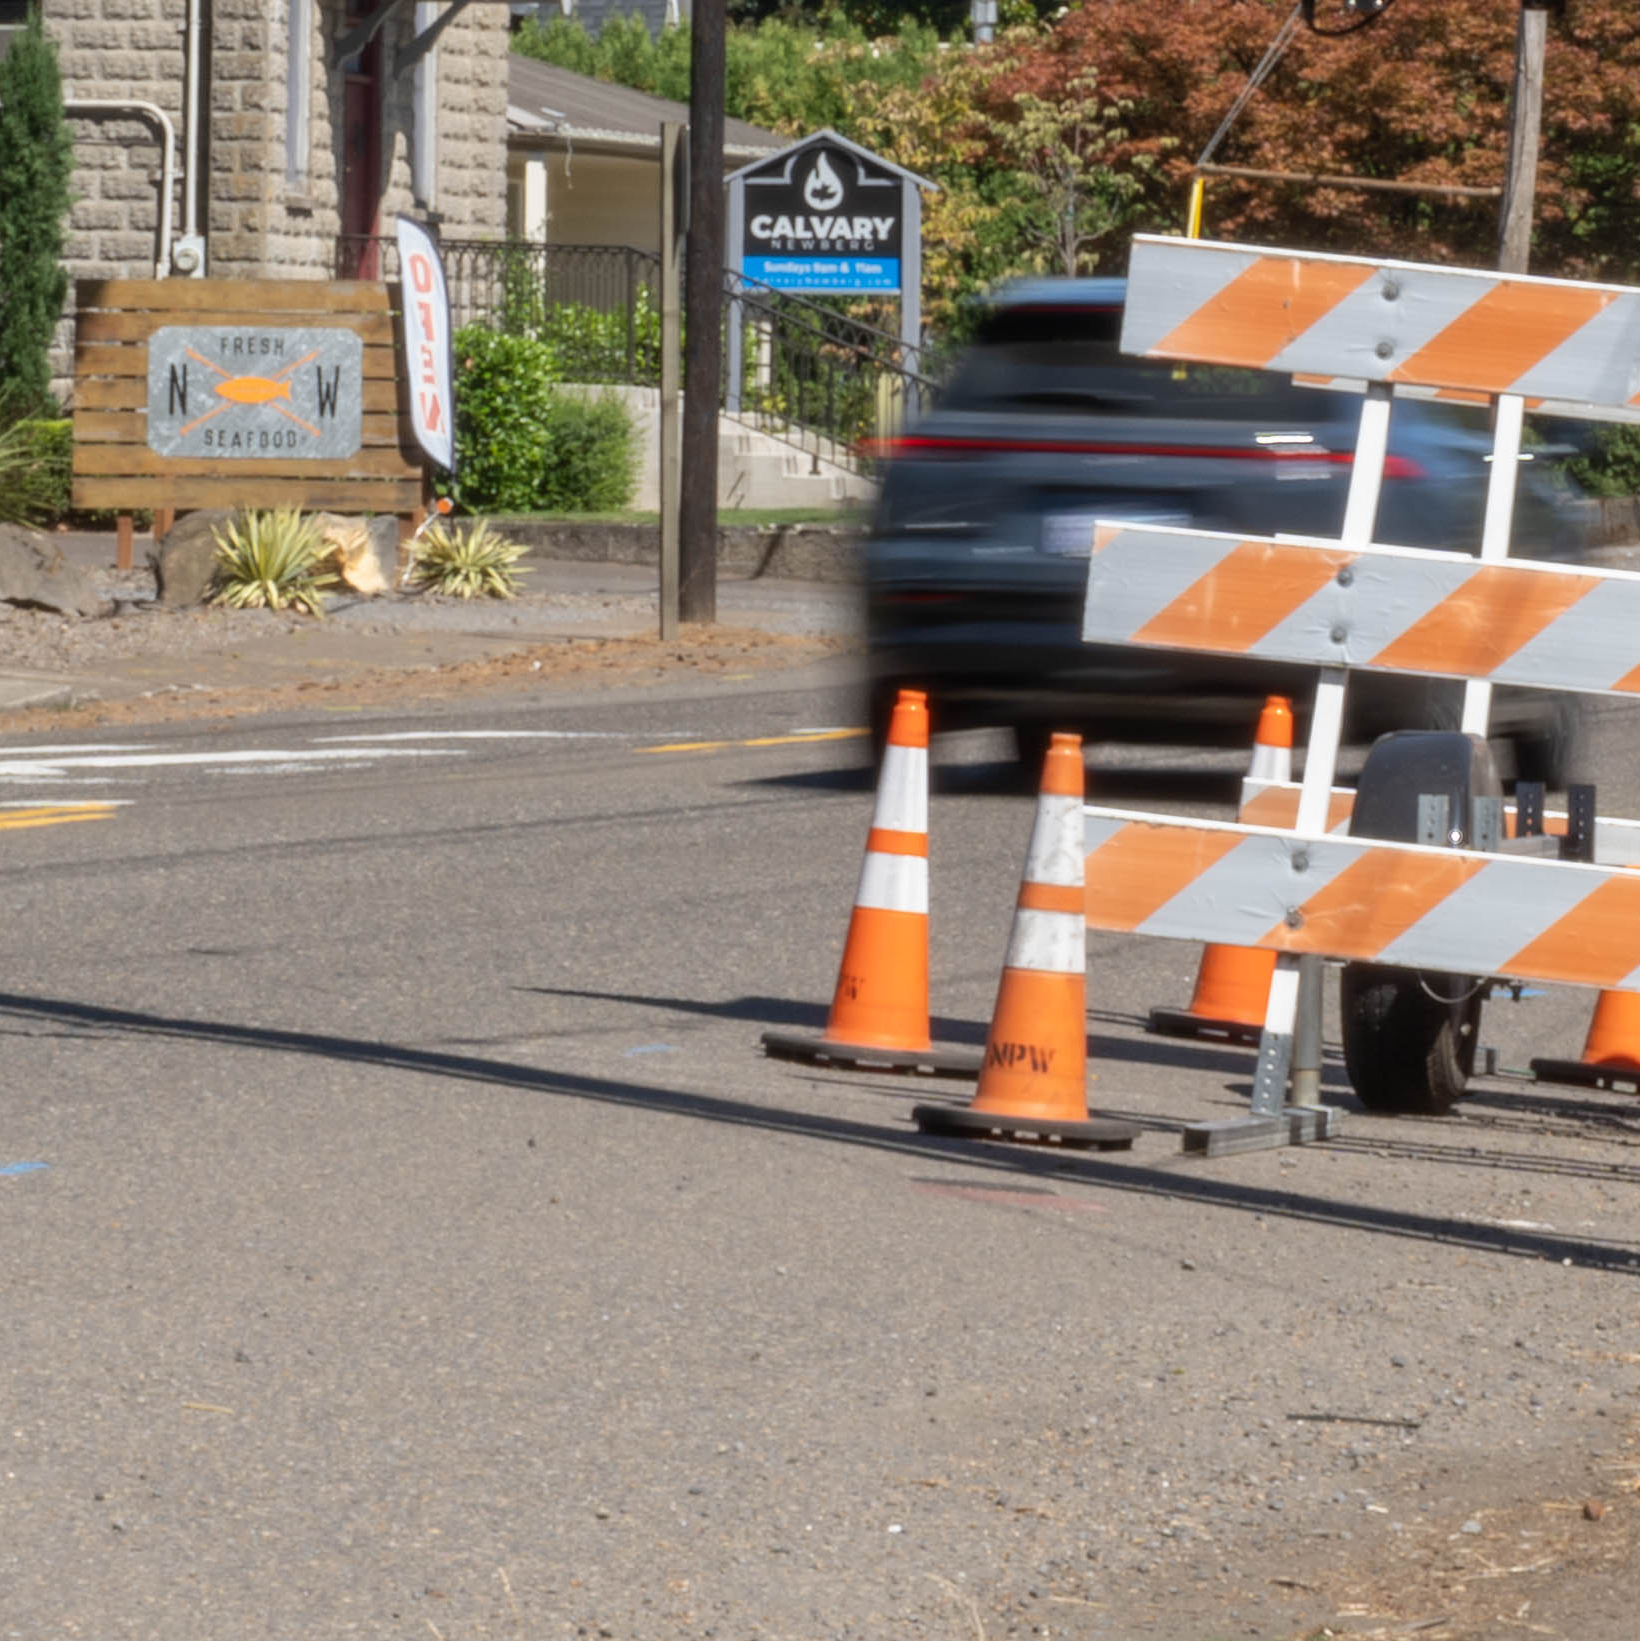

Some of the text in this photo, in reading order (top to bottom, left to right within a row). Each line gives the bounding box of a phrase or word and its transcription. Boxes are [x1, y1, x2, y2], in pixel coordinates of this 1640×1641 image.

[750, 214, 895, 241] CALVARY
[771, 239, 875, 251] NEWBERG
[763, 260, 811, 275] Sundays
[220, 337, 284, 355] FRESH
[168, 363, 340, 418] N W
[204, 429, 297, 448] SEAFOOD
[988, 1041, 1056, 1073] NPW
